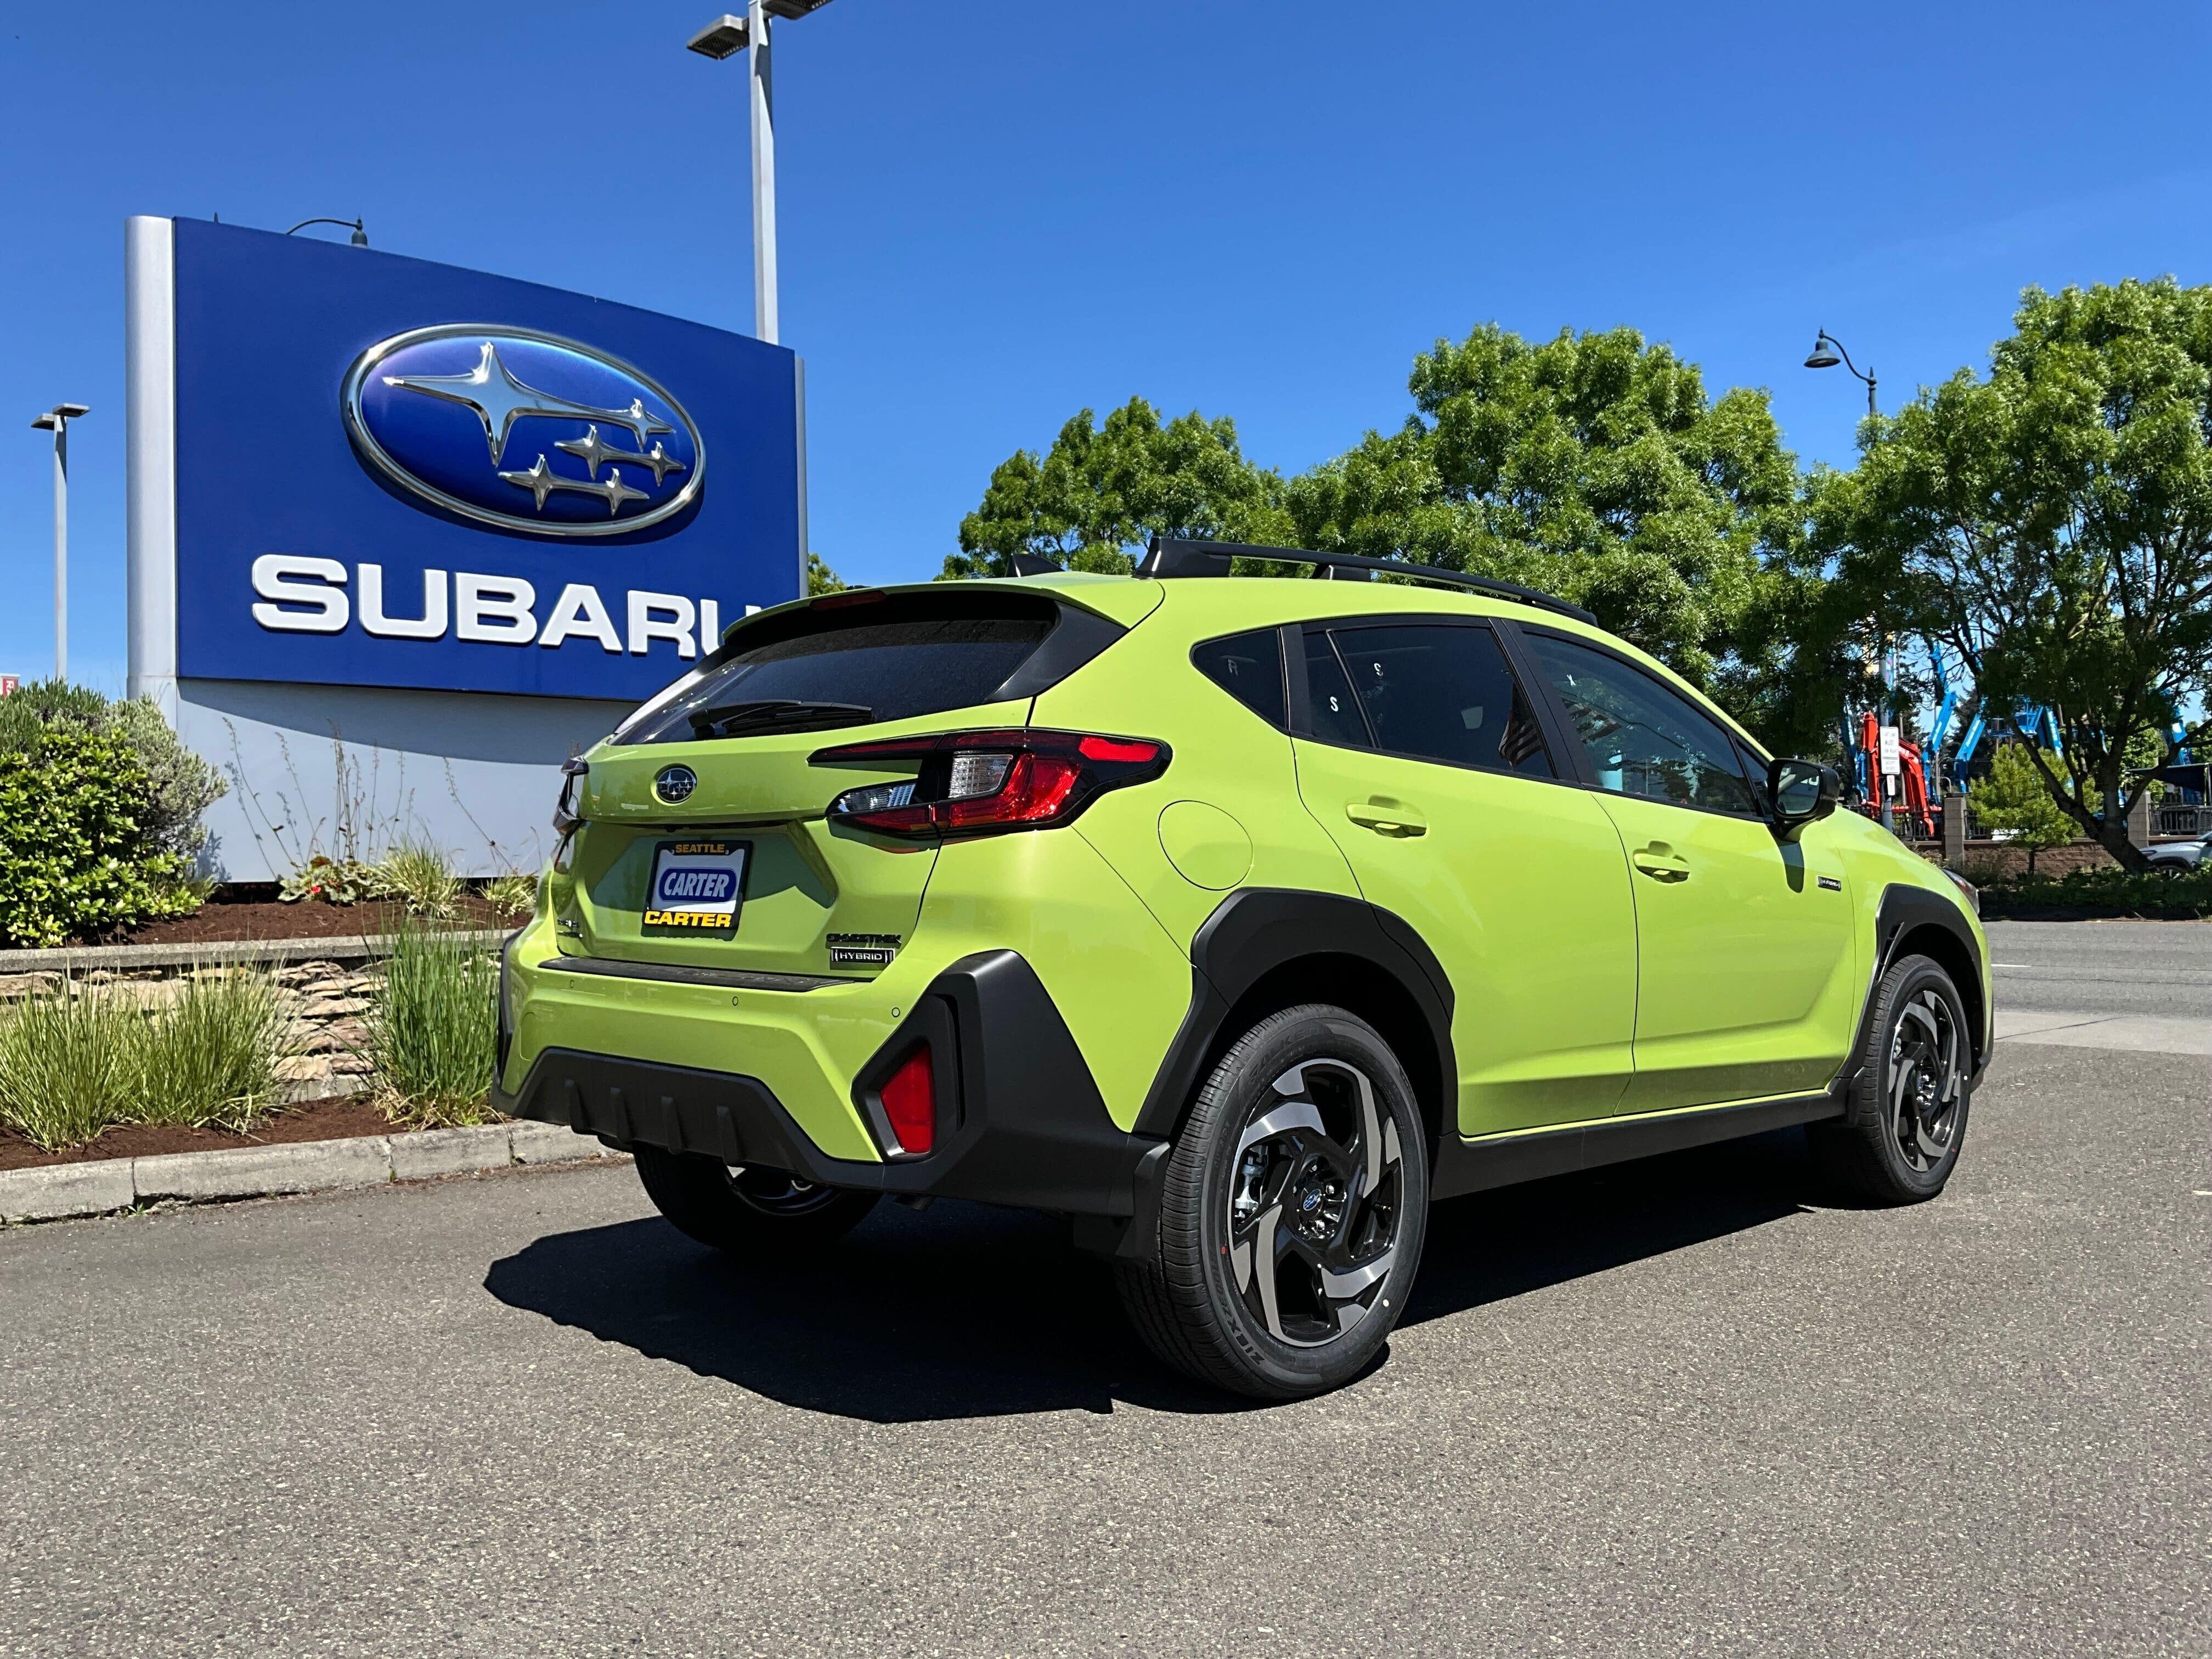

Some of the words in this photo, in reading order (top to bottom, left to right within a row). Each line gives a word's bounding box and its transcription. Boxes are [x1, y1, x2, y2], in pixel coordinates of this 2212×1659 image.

[1330, 696, 1339, 712] S
[675, 843, 725, 854] SEATTLE
[663, 872, 730, 898] CARTER
[644, 910, 731, 927] CARTER
[840, 952, 883, 960] HYBRID
[1227, 1317, 1265, 1365] ZIEX
